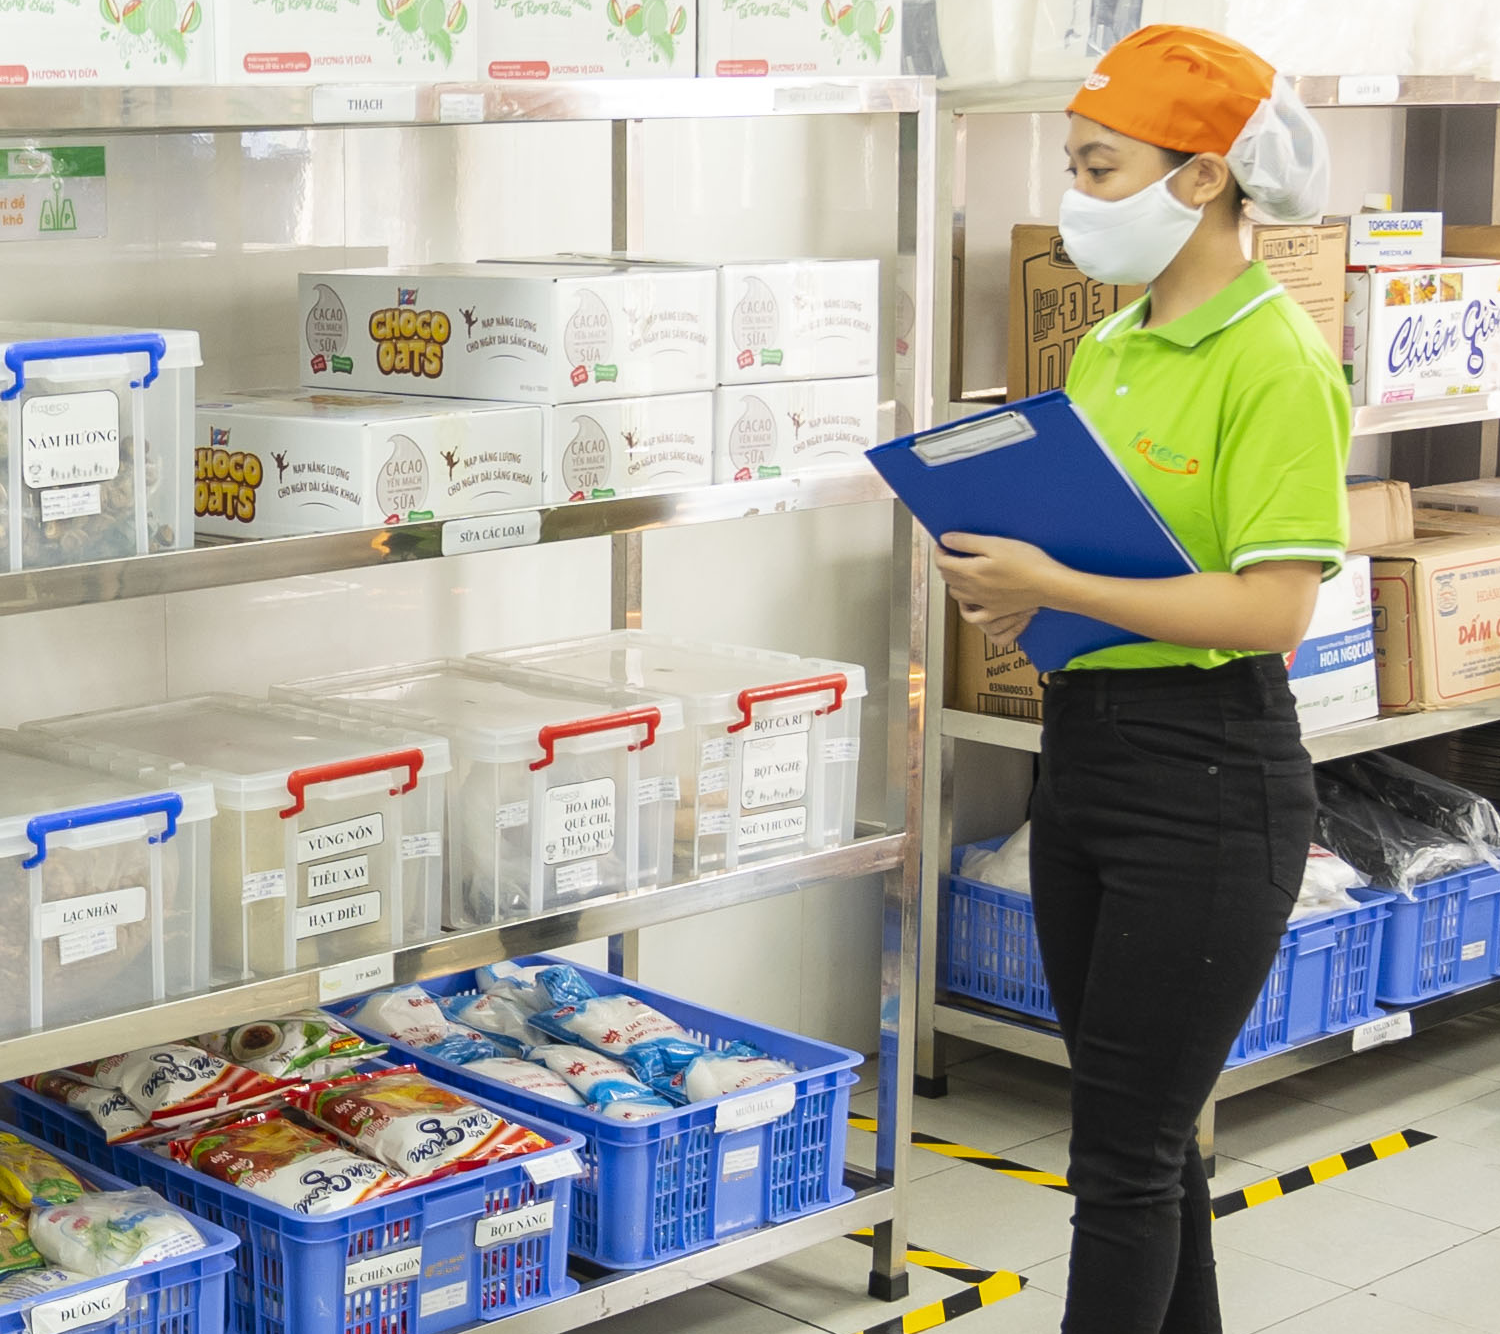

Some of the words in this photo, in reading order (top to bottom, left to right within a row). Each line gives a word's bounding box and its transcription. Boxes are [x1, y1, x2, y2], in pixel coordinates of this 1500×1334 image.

[78, 68, 98, 79] DỪA
[347, 98, 383, 113] THẠCH
[2, 214, 24, 226] khô
[1379, 249, 1412, 257] MEDIUM
[314, 308, 342, 321] CACAO
[740, 300, 774, 315] CACAO
[369, 308, 451, 344] CHOCO
[573, 314, 606, 329] CACAO
[318, 338, 337, 352] SỮA
[1388, 314, 1459, 374] Chiên
[65, 428, 118, 446] HƯƠNG
[386, 459, 423, 475] CACAO
[447, 483, 461, 496] CHO
[392, 492, 415, 510] SỮA
[459, 527, 479, 542] SỮA
[480, 525, 500, 540] CÁC
[502, 523, 525, 538] LOẠI
[1458, 613, 1491, 645] DẤM
[1319, 651, 1340, 668] HOA
[771, 817, 802, 831] HƯƠNG
[342, 865, 367, 881] XAY
[63, 909, 84, 924] LẠC
[85, 902, 118, 919] NHÂN
[308, 910, 335, 929] HẠT
[490, 1220, 514, 1238] BỘT
[517, 1212, 547, 1230] NĂNG
[360, 1264, 394, 1284] CHIÊN
[60, 1296, 111, 1323] ĐƯỜNG
